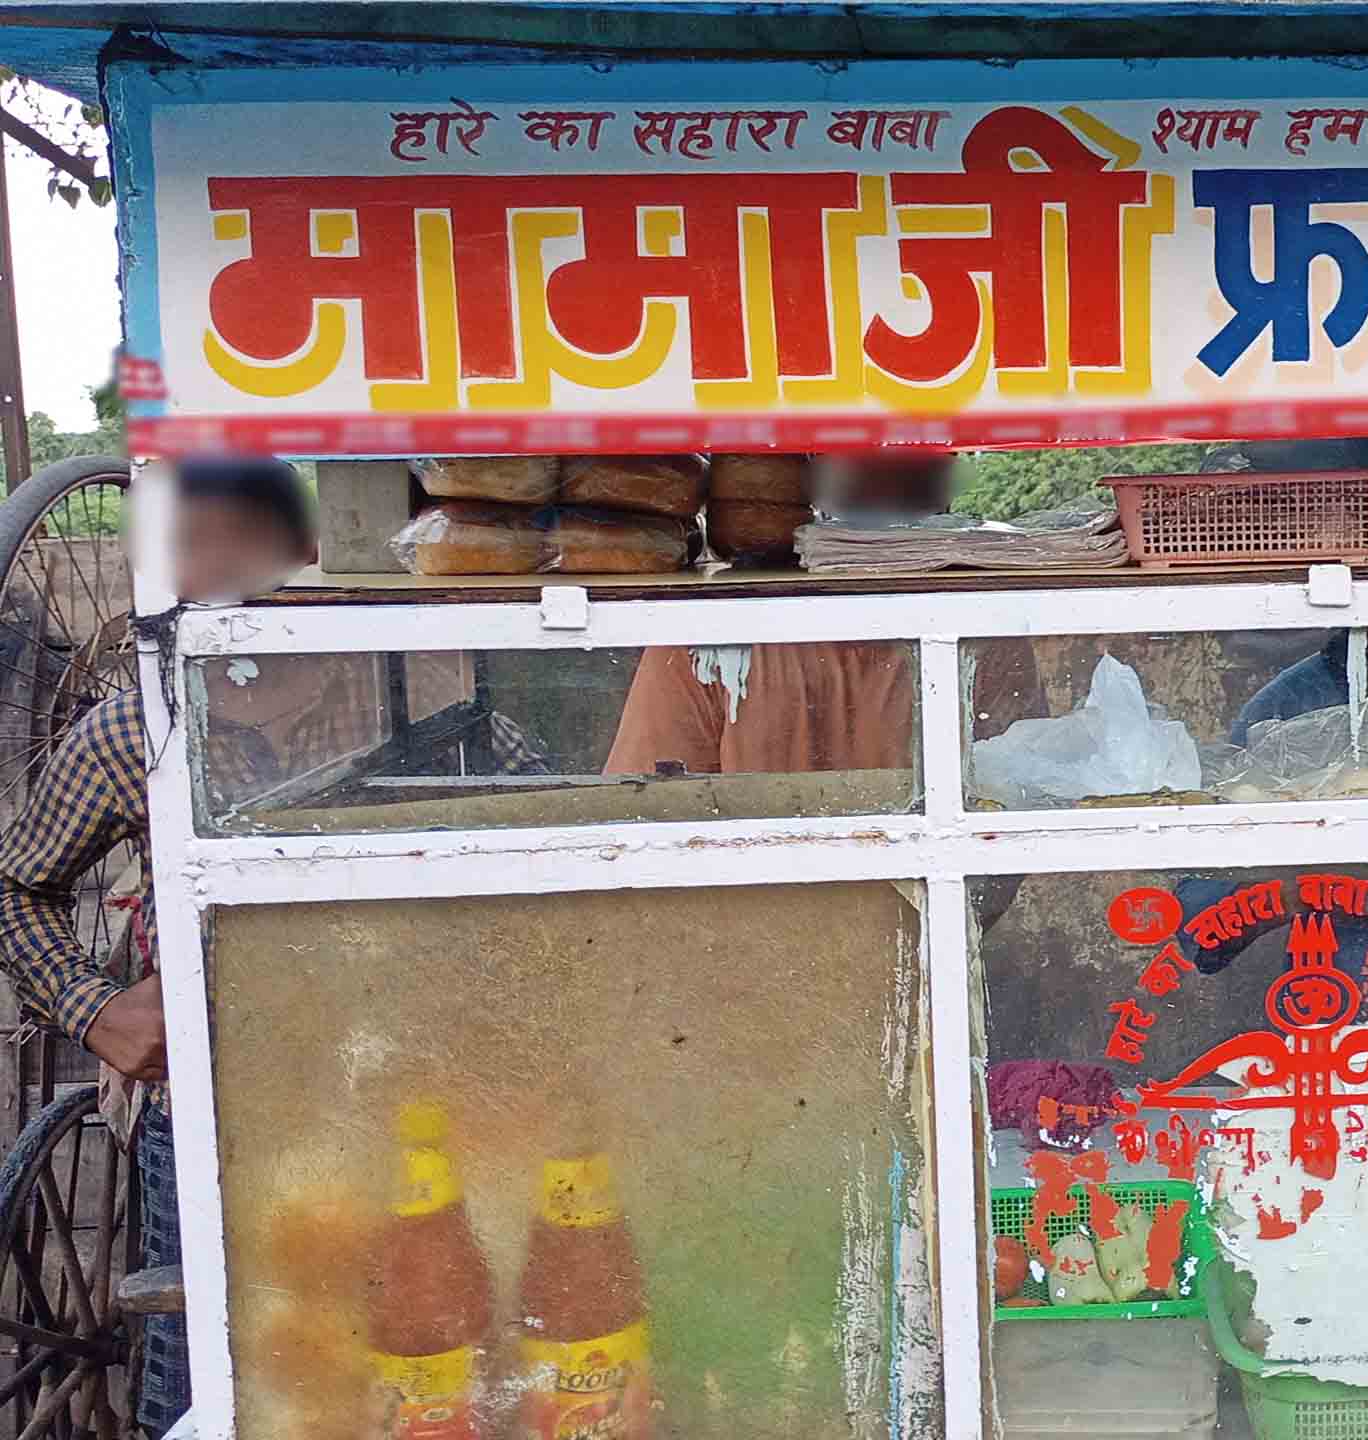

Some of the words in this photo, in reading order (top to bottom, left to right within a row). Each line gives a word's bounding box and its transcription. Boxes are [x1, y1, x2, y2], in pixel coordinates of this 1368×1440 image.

[389, 97, 499, 162] हारे
[518, 110, 616, 153] का
[632, 109, 807, 160] सहारा
[825, 110, 951, 153] बाबा
[1151, 107, 1262, 154] श्याम
